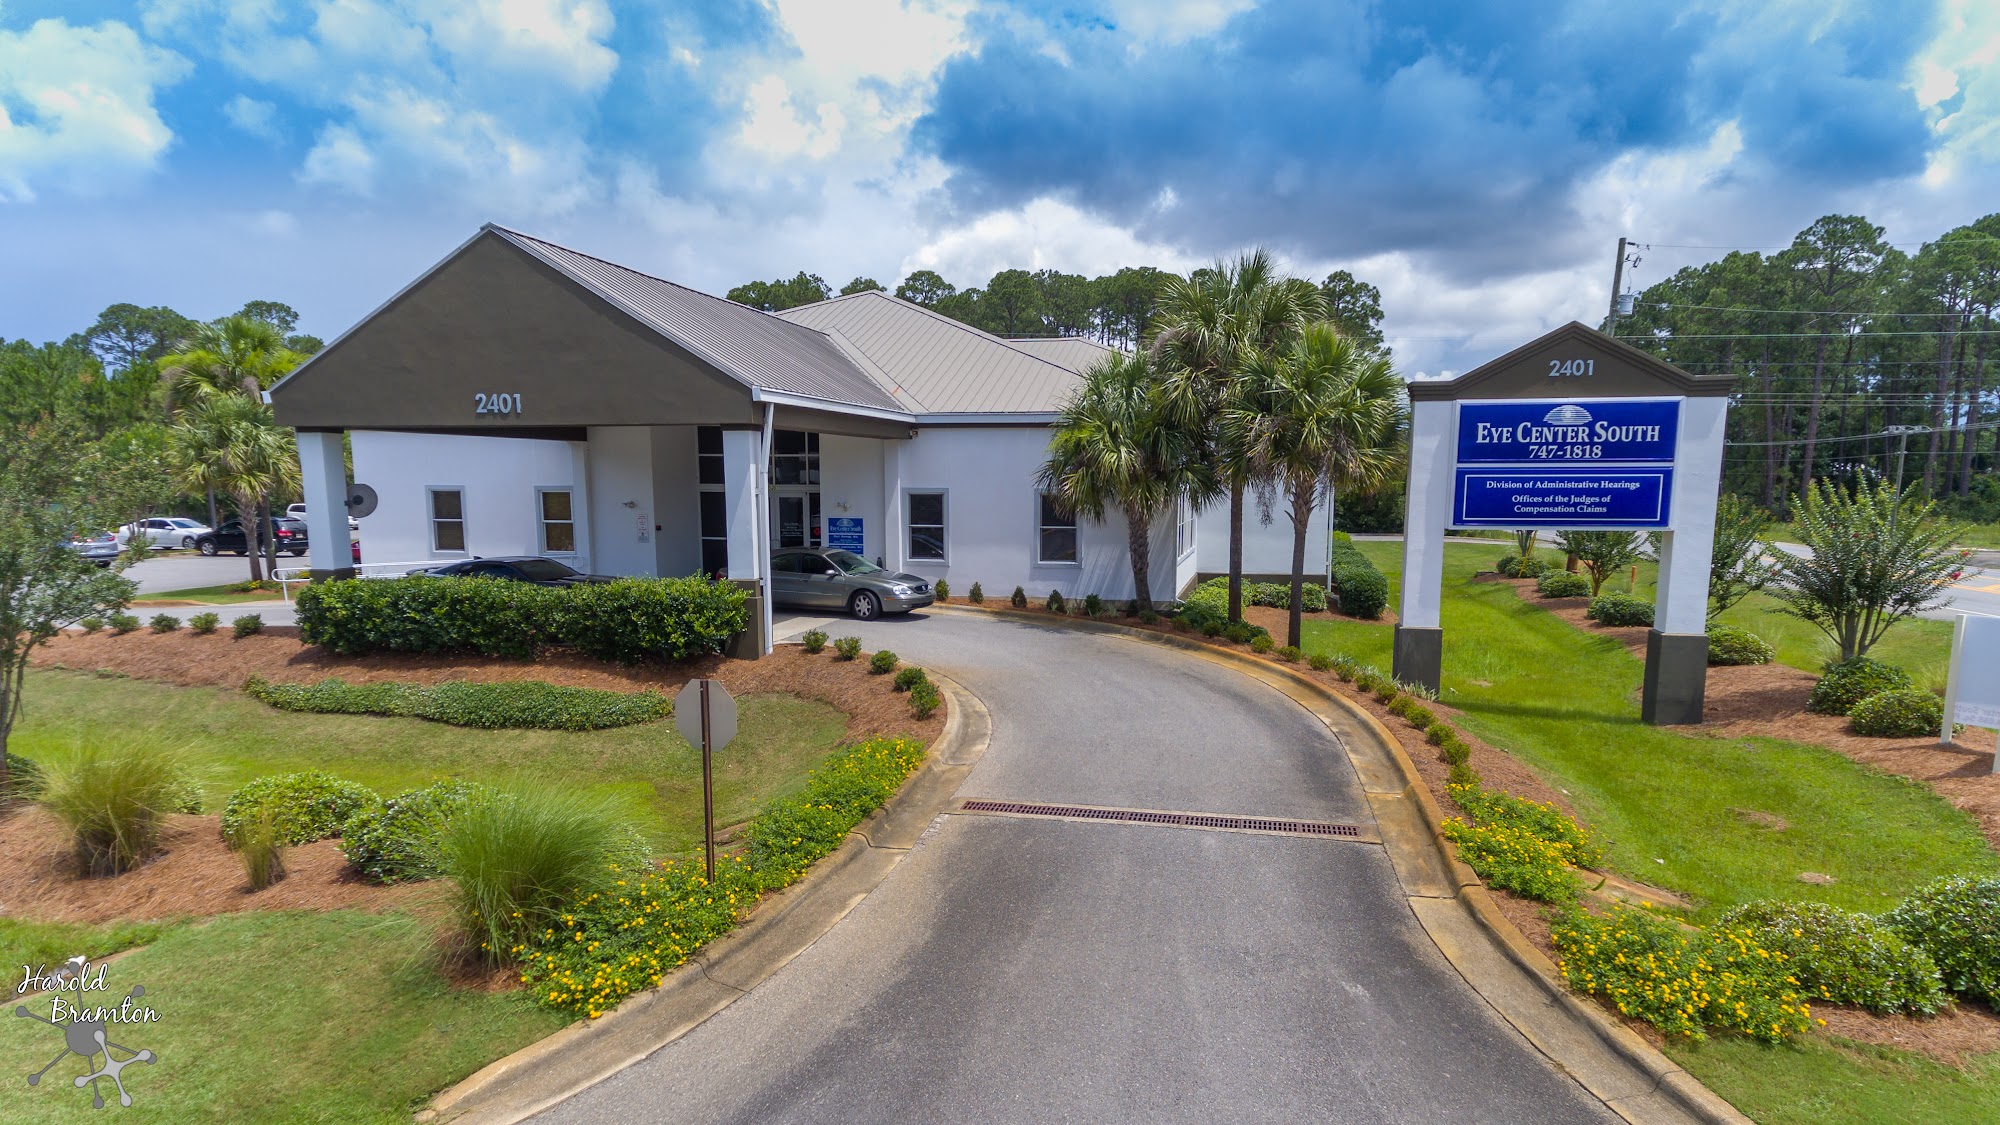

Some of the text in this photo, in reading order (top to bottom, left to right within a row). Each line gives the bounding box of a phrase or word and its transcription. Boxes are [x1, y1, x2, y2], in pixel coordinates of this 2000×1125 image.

[1548, 359, 1595, 377] 2401
[474, 393, 522, 414] 2401
[1476, 420, 1661, 443] EYE CENTER SOUTH
[1528, 444, 1602, 459] 747-1818
[1486, 480, 1641, 491] Division of Administrative Hearings
[1511, 494, 1612, 505] Offices of the Judges of
[1514, 504, 1608, 515] Compensation Claims
